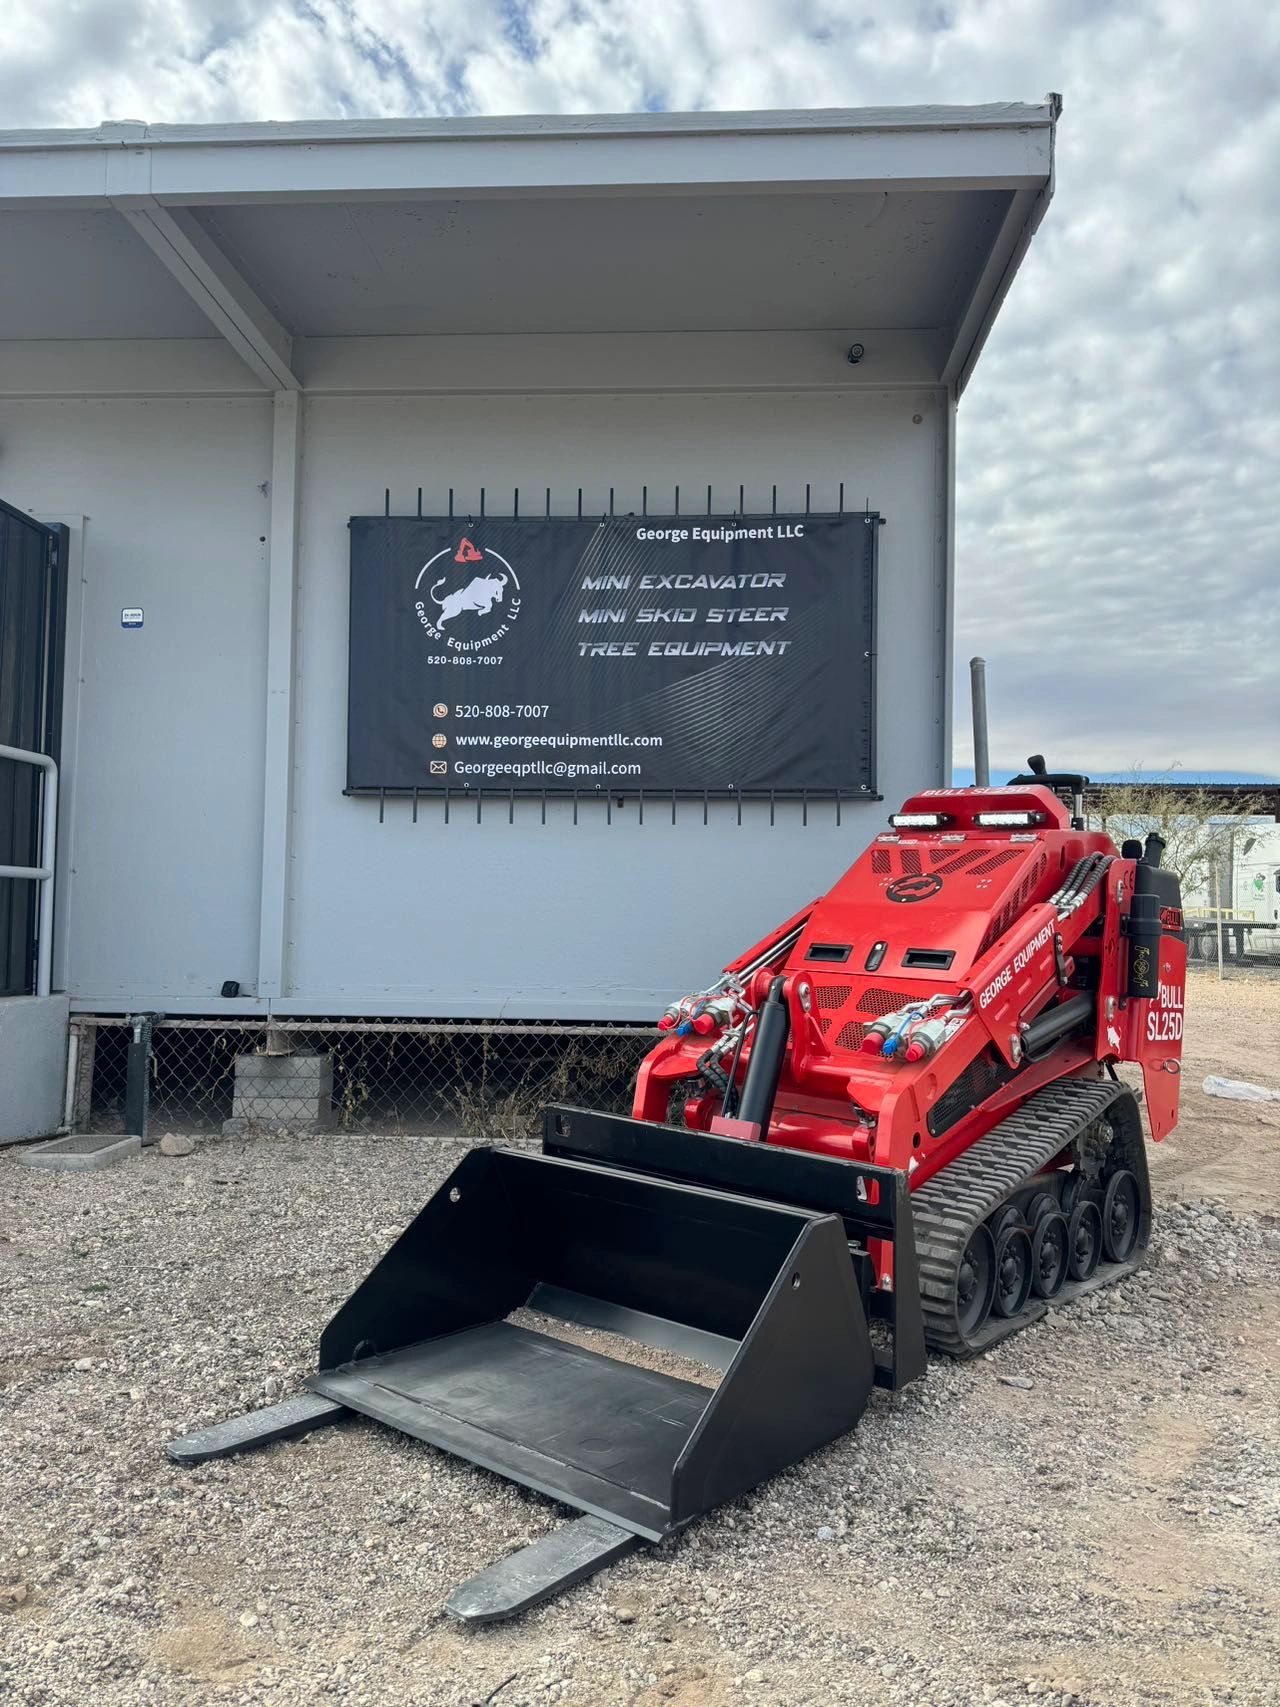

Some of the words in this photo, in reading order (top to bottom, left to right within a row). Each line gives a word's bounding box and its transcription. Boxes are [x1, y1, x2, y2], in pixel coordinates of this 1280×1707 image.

[635, 527, 689, 542] George
[691, 525, 774, 543] Equipment
[776, 524, 805, 539] LLC
[581, 574, 632, 590] MINI
[639, 572, 787, 590] EXCAVATOR
[415, 601, 442, 640] George
[447, 624, 510, 651] Equipment
[507, 598, 521, 620] LLC
[577, 608, 629, 624] MINI
[635, 607, 698, 623] SKID
[705, 607, 790, 623] STEER
[577, 642, 640, 657] TREE
[647, 640, 792, 657] EQUIPMENT
[427, 655, 504, 665] 520-808-7007
[454, 704, 550, 718] 520-808-7007
[455, 733, 664, 749] www.georgeequipmentllc.com
[454, 760, 642, 778] Georgeeqptllc@gmail.com
[921, 788, 966, 797] BULL
[979, 965, 1013, 1009] GEORGE
[1013, 918, 1055, 974] EQUIPMENT
[1161, 985, 1183, 1009] BULL
[1147, 1011, 1183, 1041] SL25D
